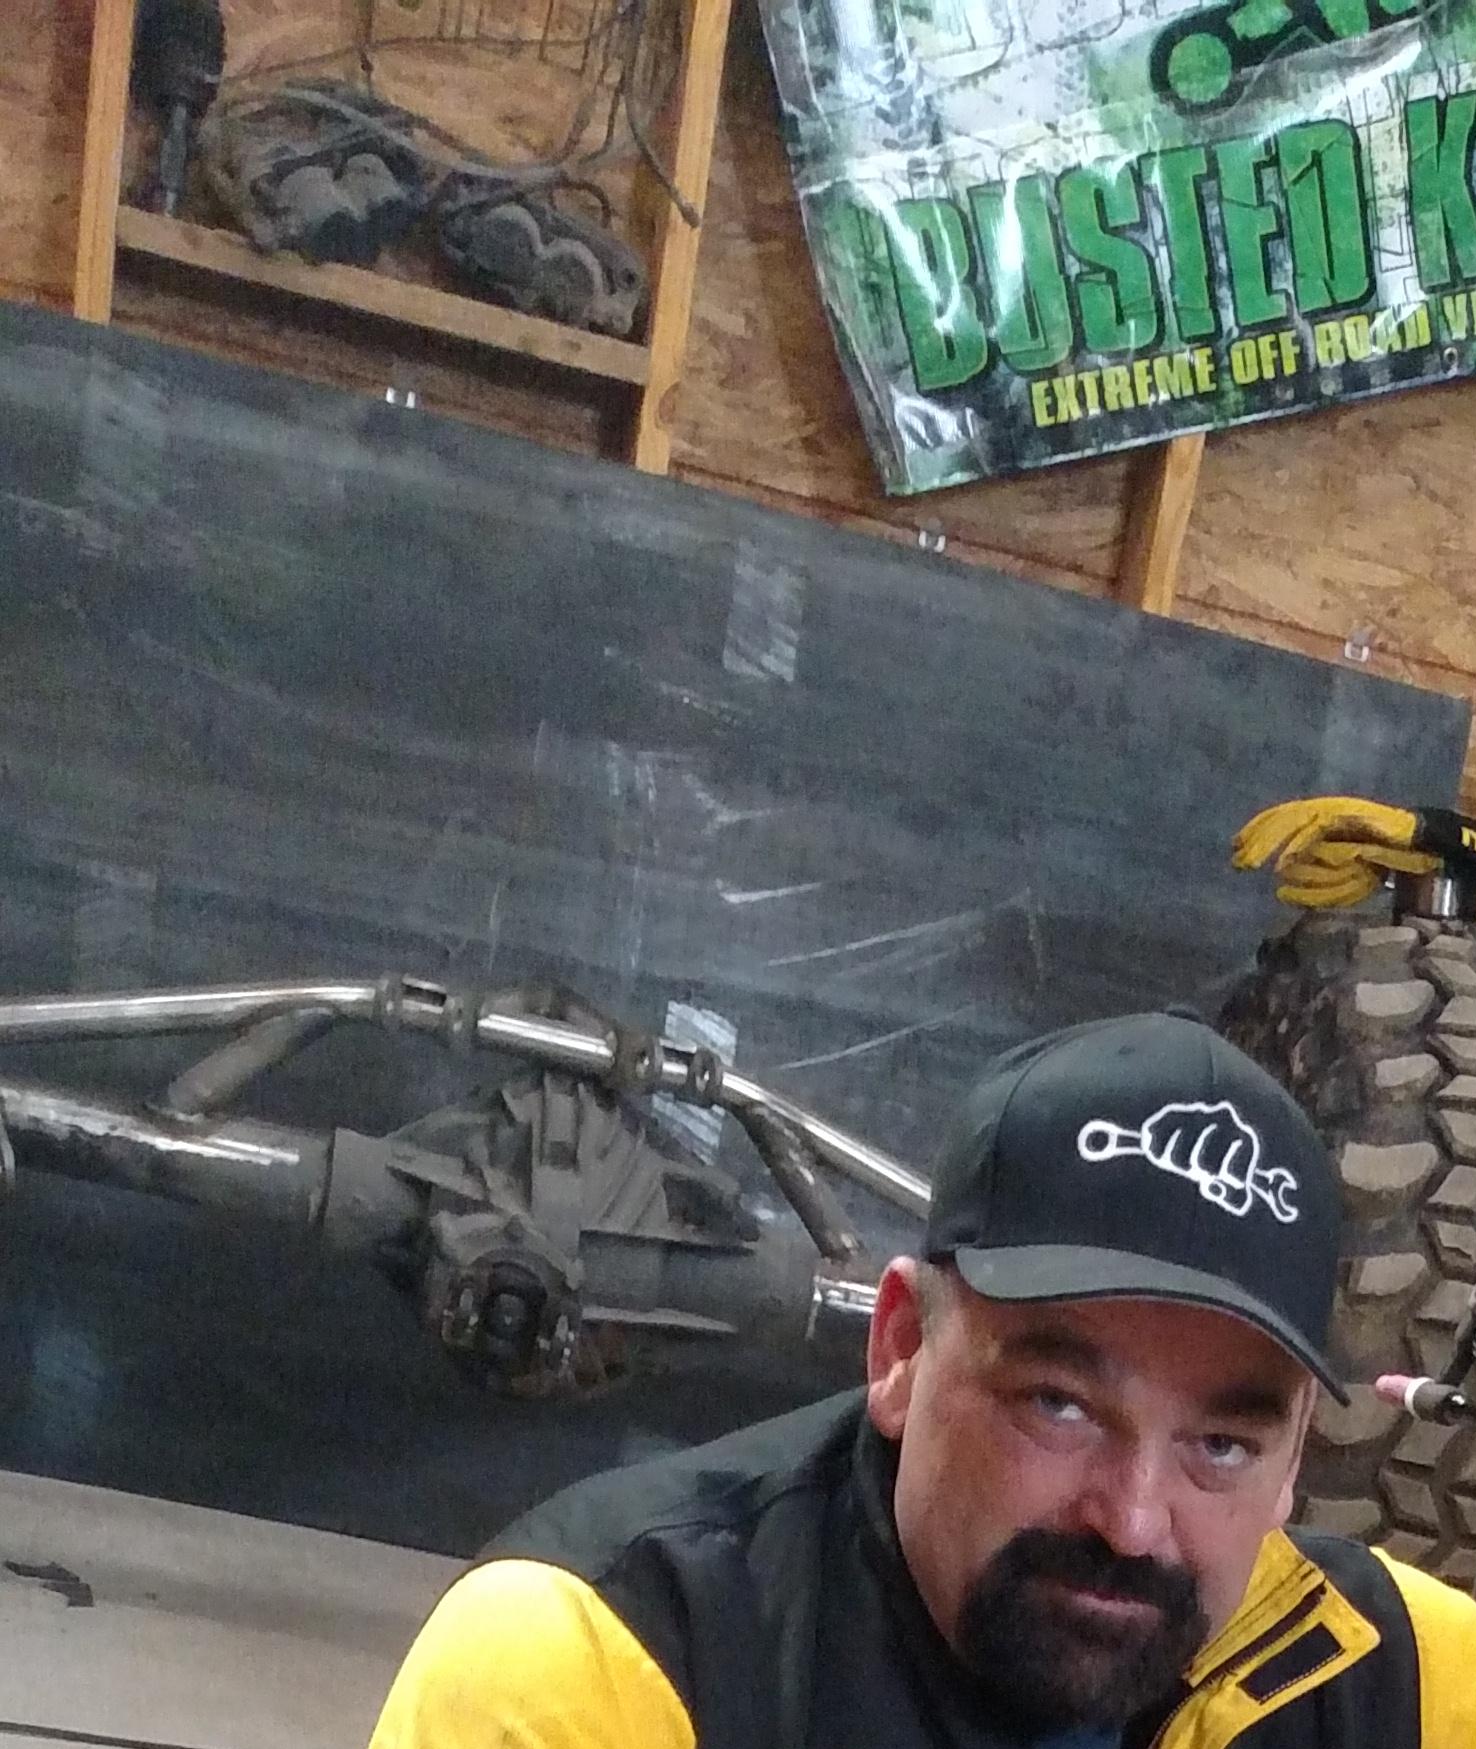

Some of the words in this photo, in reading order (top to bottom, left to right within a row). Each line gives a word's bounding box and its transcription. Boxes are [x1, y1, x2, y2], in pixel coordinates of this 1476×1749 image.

[888, 118, 1370, 391] BUSTED
[1031, 346, 1216, 427] EXTREME
[1230, 330, 1301, 384] OFF
[1314, 300, 1431, 368] ROAD
